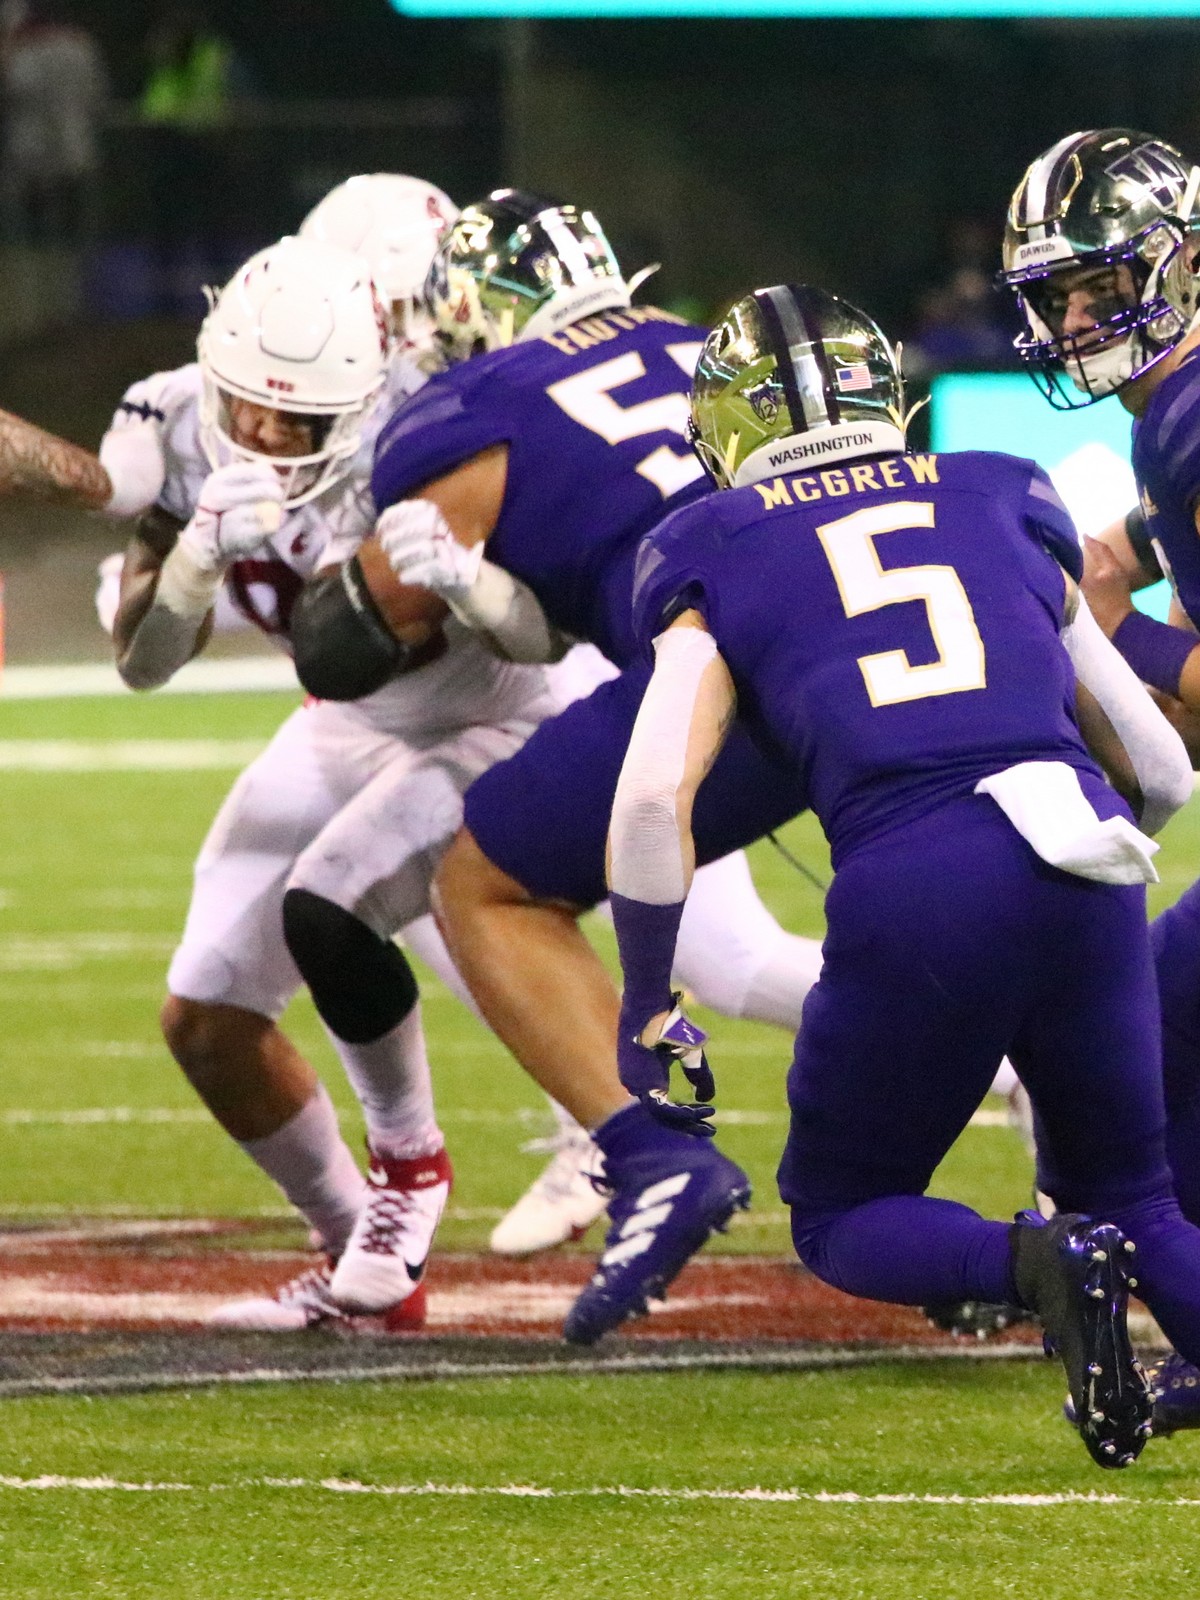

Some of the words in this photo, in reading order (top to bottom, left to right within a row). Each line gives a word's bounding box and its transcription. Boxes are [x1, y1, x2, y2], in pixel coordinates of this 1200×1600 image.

[1020, 243, 1056, 260] DAWGS
[545, 341, 706, 499] 5
[768, 432, 874, 468] WASHINGTON
[752, 454, 941, 511] MCGREW
[815, 500, 988, 709] 5
